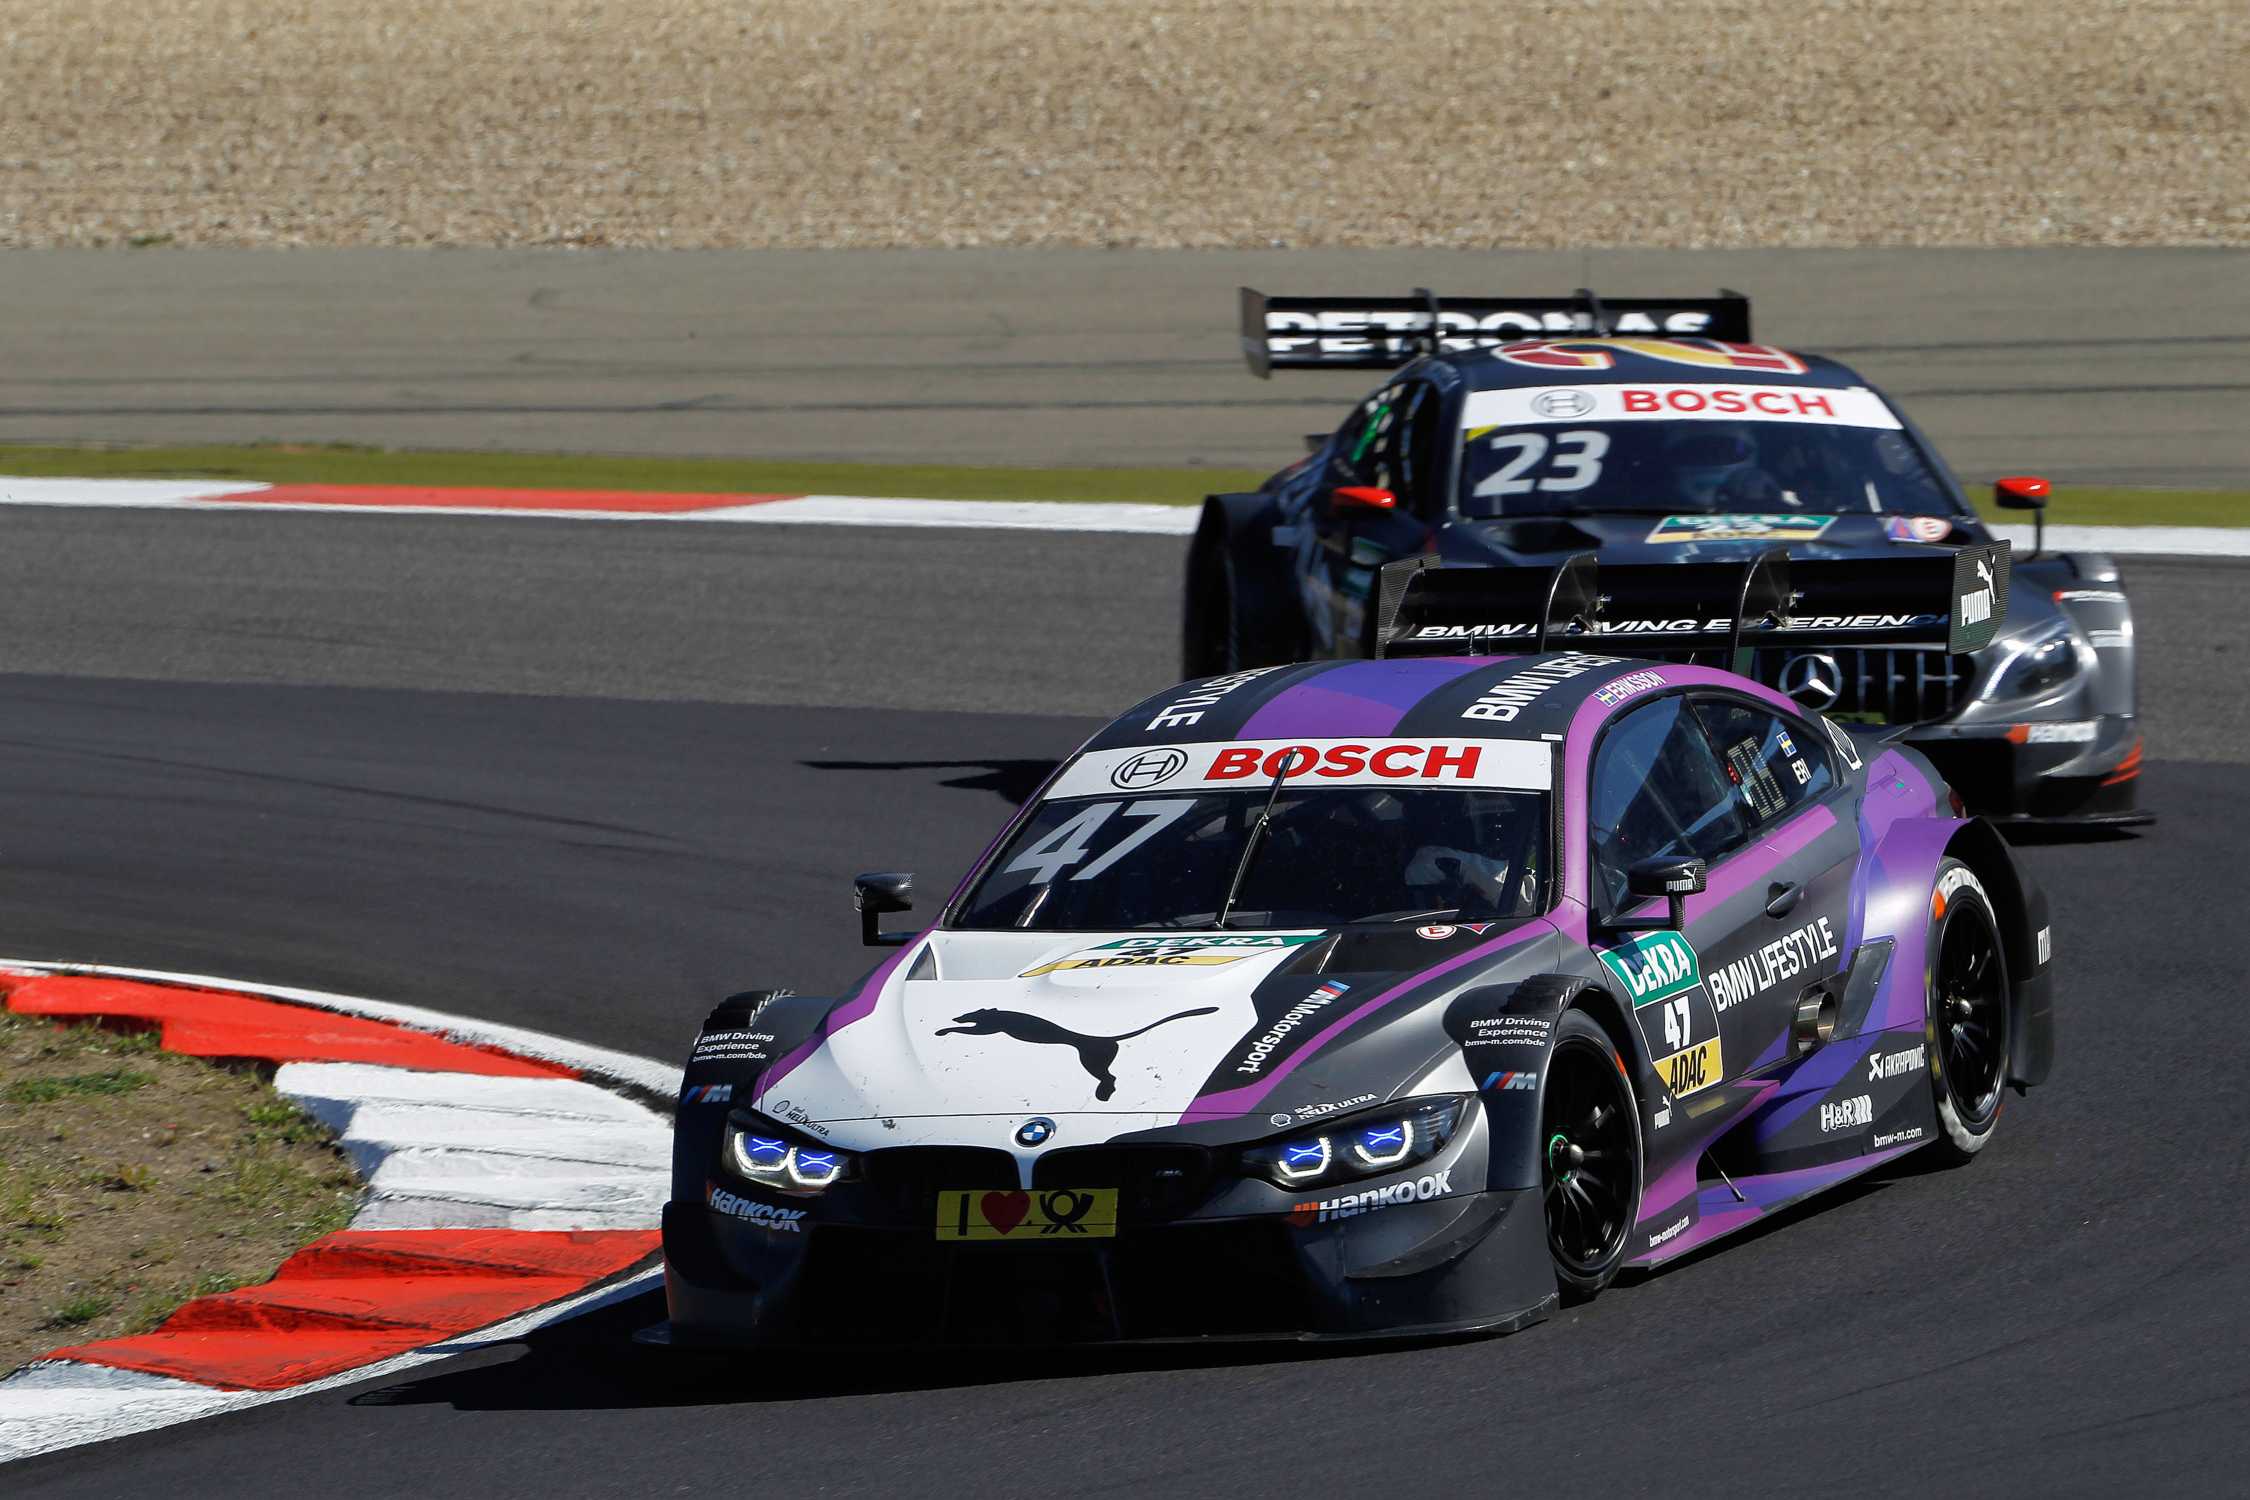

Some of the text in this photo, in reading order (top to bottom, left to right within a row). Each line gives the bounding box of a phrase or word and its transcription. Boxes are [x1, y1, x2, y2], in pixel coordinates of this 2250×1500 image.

[1620, 390, 1837, 418] BOSCH
[1472, 431, 1611, 498] 23
[1960, 588, 1992, 628] PUMA
[1416, 623, 1528, 638] BMW
[1461, 675, 1561, 723] BMW
[1609, 671, 1667, 700] ERIKSSON
[1203, 744, 1484, 781] BOSCH
[1791, 757, 1812, 785] ERI
[1004, 799, 1200, 885] 47
[1665, 878, 1694, 892] PUMA
[1119, 937, 1286, 948] DEKRA
[1072, 955, 1192, 969] ADAC
[1617, 938, 1692, 997] DEKRA
[1708, 917, 1837, 1012] BMW LIFESTYLE
[1470, 1017, 1551, 1030] BMW Driving
[1478, 1027, 1548, 1038] Experience
[1664, 995, 1691, 1051] 47
[696, 1042, 760, 1054] Experience
[700, 1032, 775, 1044] BMW Driving
[1236, 1003, 1322, 1074] Motorsport
[1464, 1038, 1546, 1047] bmw-m.com/bde
[693, 1052, 767, 1063] bmw-m.com/bde
[1669, 1045, 1708, 1096] ADAC
[1337, 1093, 1378, 1109] ULTRA
[1820, 1099, 1857, 1133] H&R
[1874, 1127, 1923, 1148] bmw-m.com
